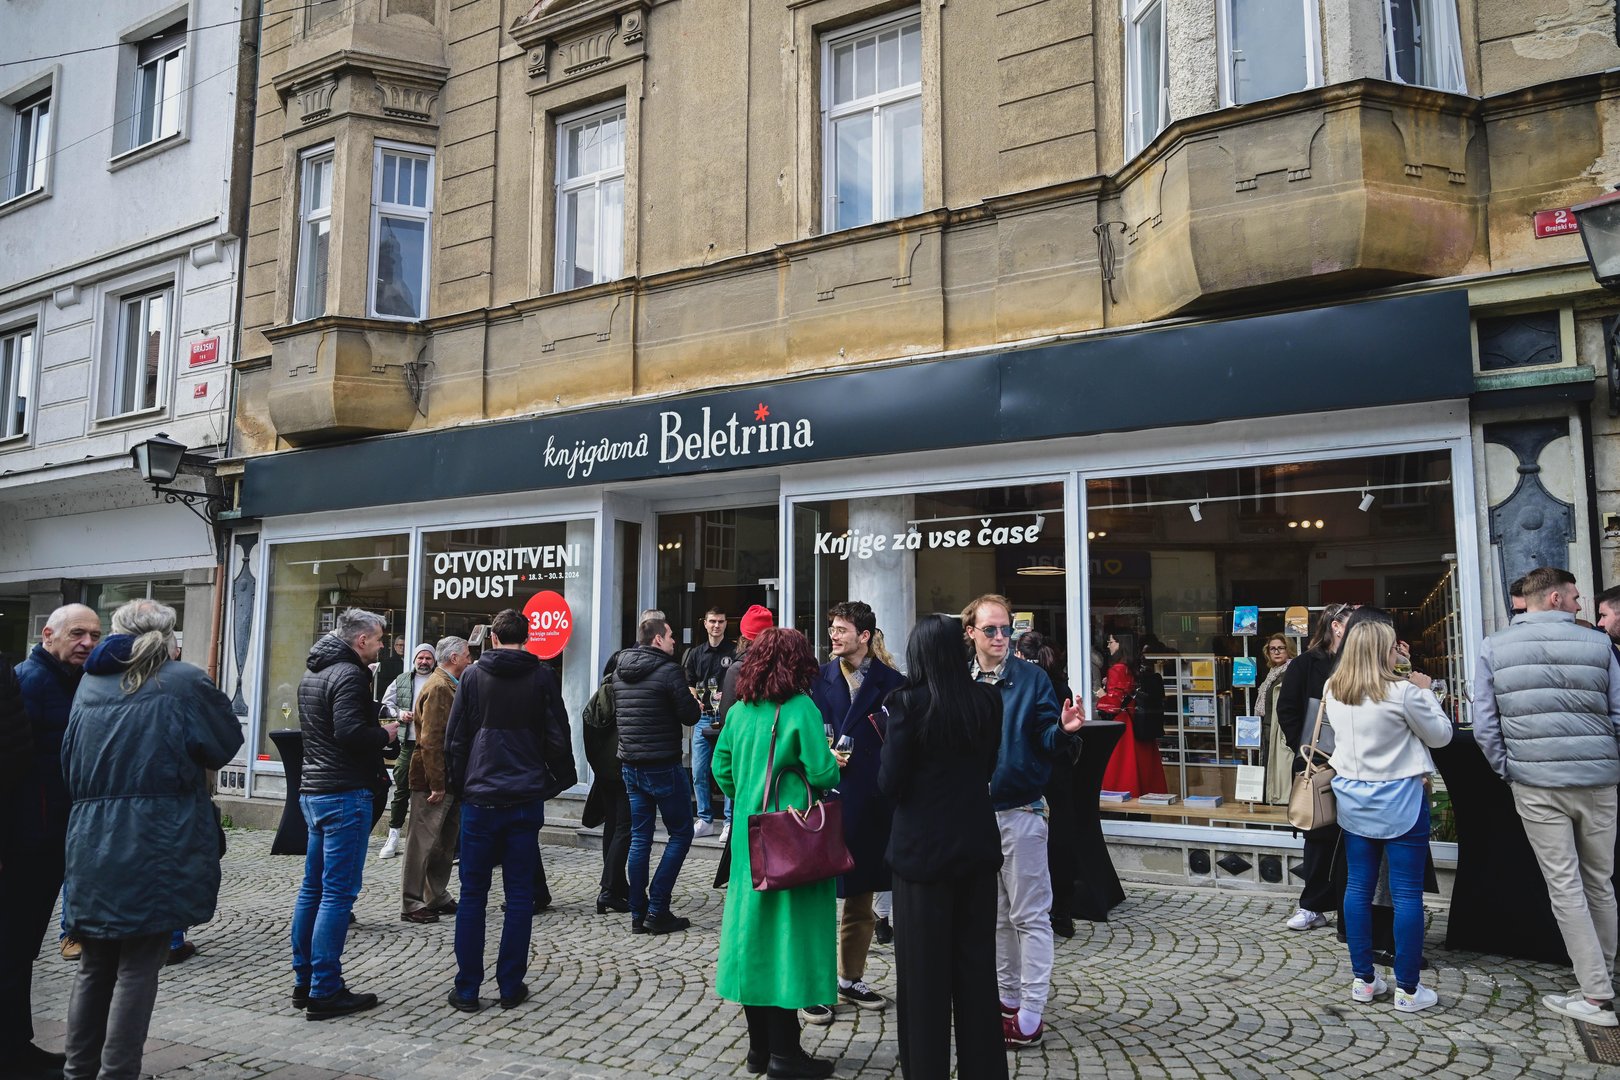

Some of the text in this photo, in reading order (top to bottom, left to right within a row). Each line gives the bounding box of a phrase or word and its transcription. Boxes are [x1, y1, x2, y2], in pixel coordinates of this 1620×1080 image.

[1545, 224, 1568, 232] Grajski
[1554, 210, 1568, 224] 2
[193, 342, 214, 354] GRAJSKI
[543, 402, 814, 480] knjigarna Beletrina
[814, 518, 1040, 561] Knjige za vse čase
[434, 544, 580, 574] OTVORITVENI
[433, 575, 518, 600] POPUST
[528, 611, 568, 630] 30%
